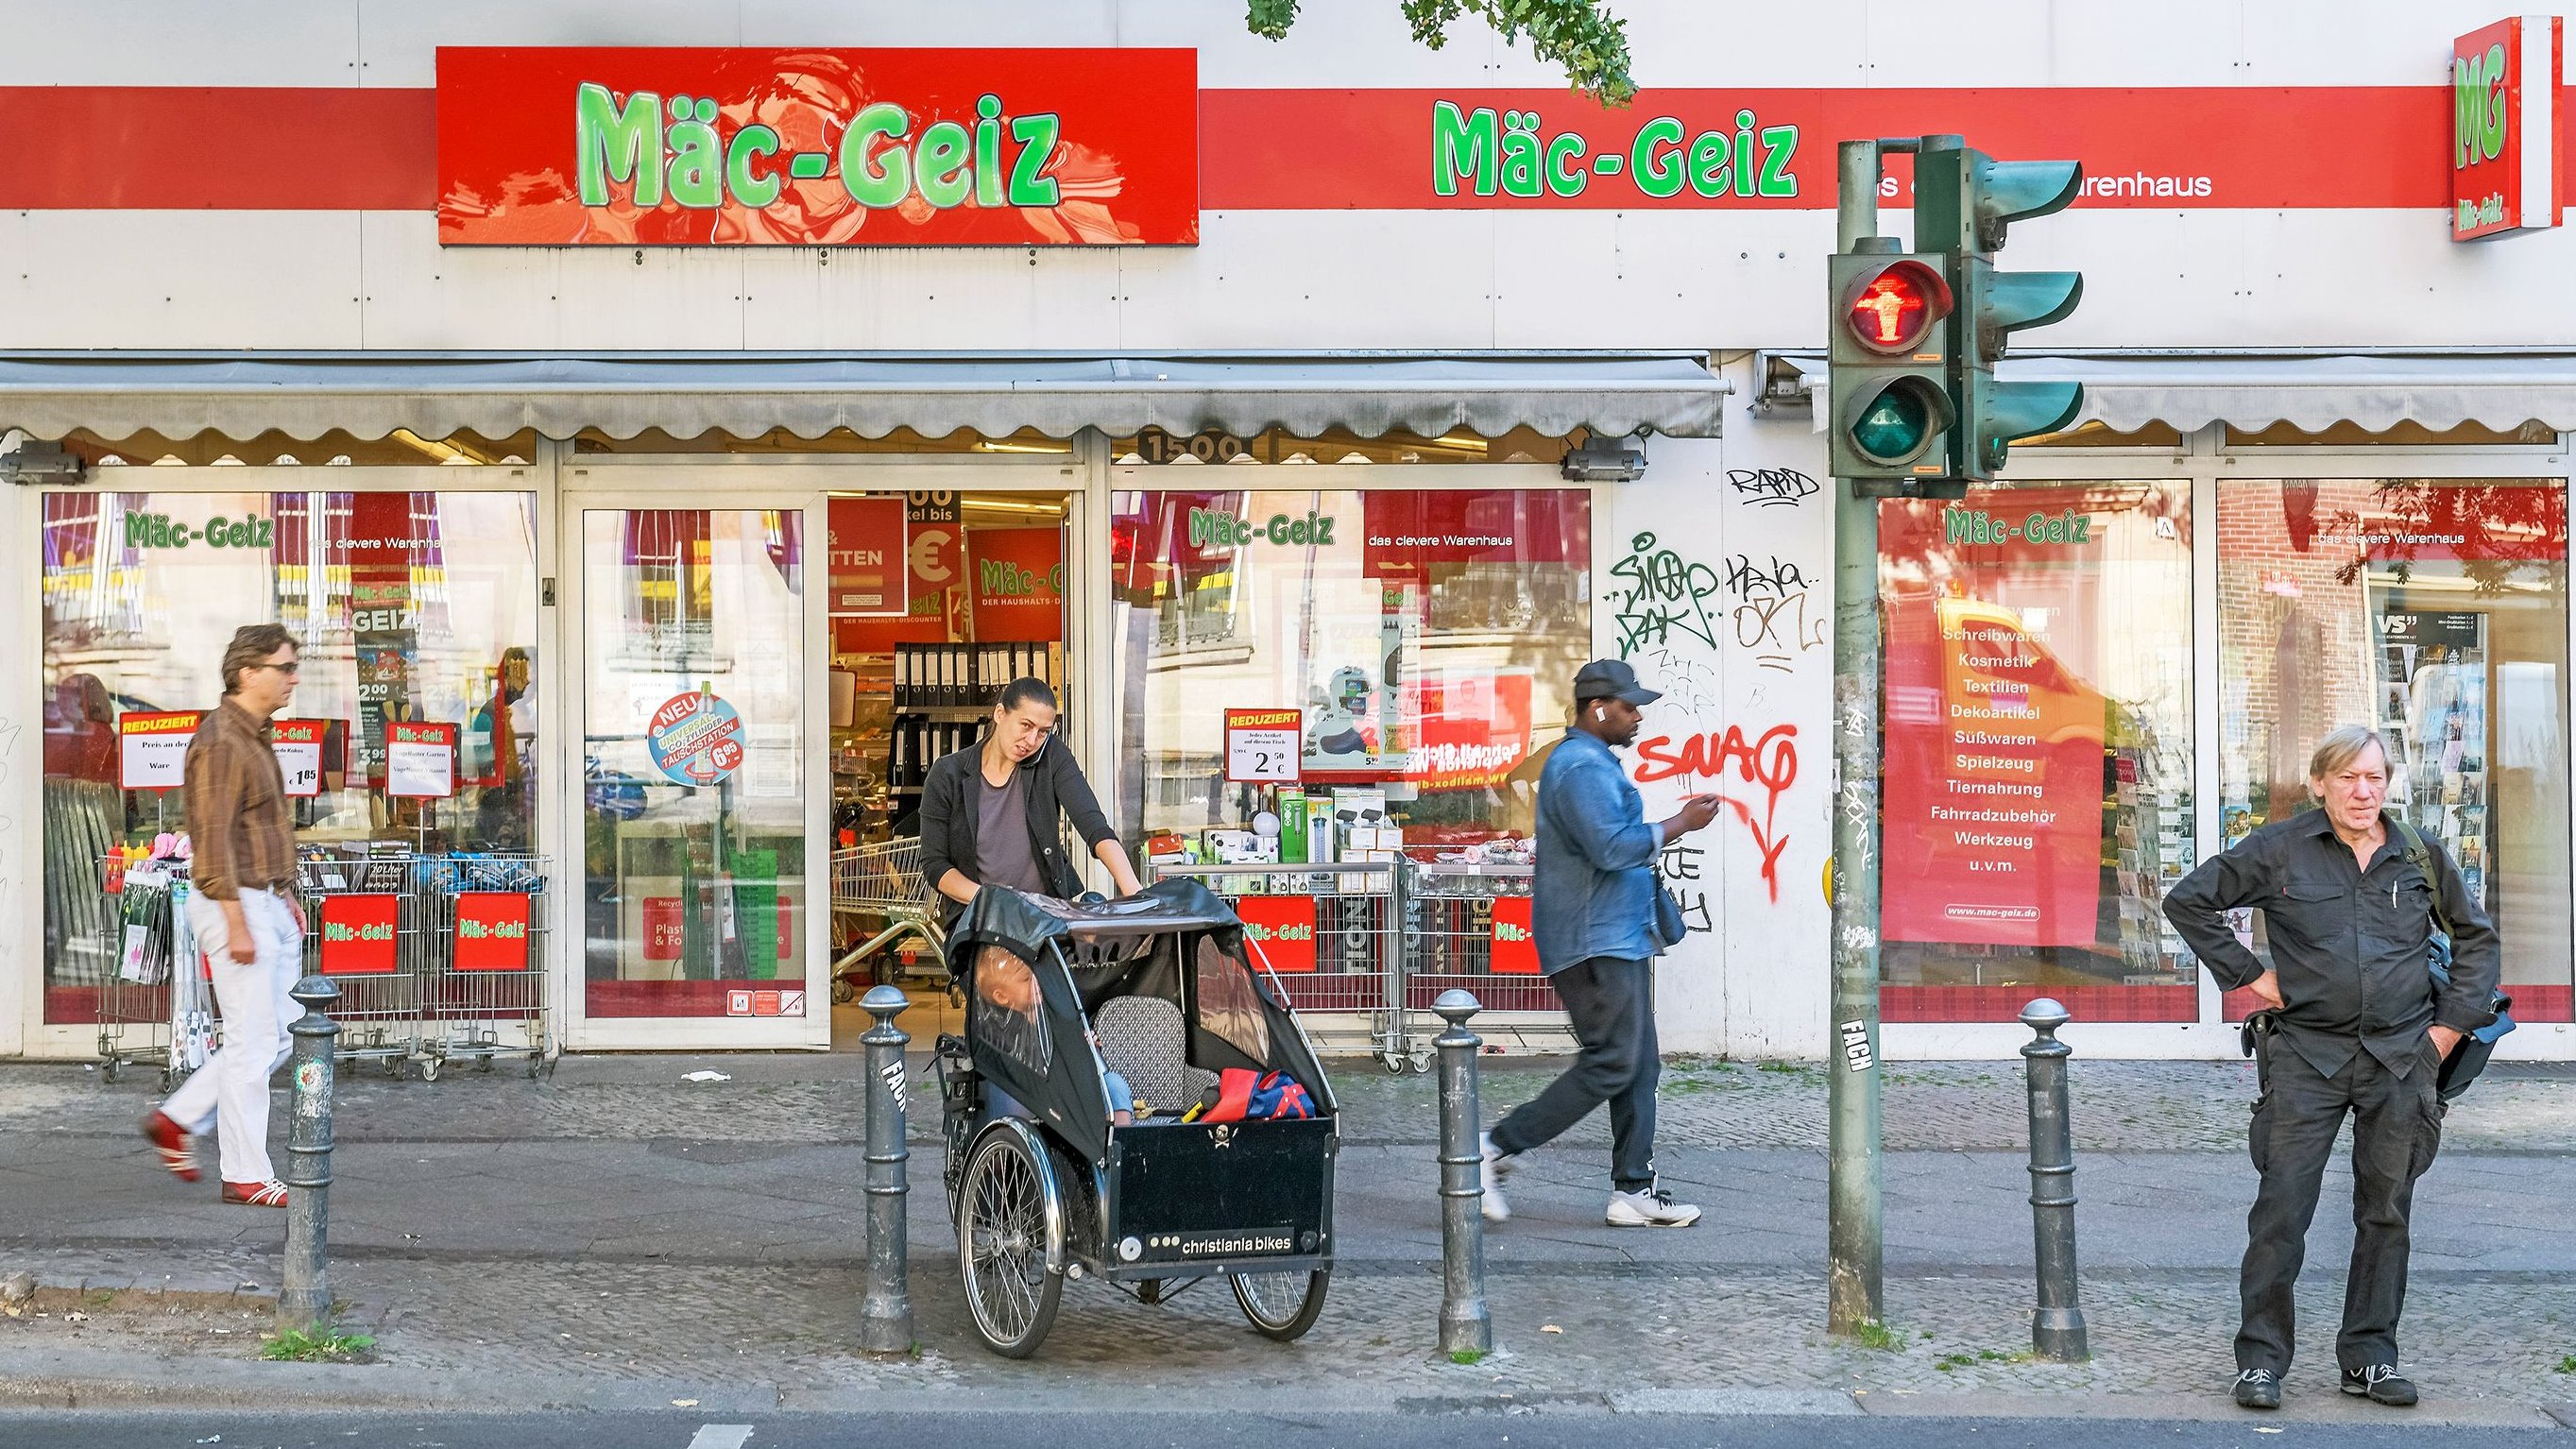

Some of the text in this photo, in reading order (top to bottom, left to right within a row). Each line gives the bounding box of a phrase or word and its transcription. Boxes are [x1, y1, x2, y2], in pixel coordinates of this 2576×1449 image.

[2455, 42, 2507, 171] MG
[575, 80, 1060, 210] Mäc-Geiz
[1433, 99, 1799, 197] Mäc-Geiz
[2078, 171, 2212, 196] renhaus
[1148, 435, 1243, 462] 1500
[930, 507, 953, 520] bis
[124, 509, 276, 550] Mäc-Geiz
[1188, 506, 1337, 548] Mäc-Geiz
[1945, 507, 2091, 545] Mäc-Geiz
[336, 537, 382, 549] clevere
[1369, 535, 1513, 546] das clevere Warenhaus
[2317, 534, 2465, 544] das clevere Warenhaus
[828, 550, 883, 566] TTEN
[352, 608, 417, 633] GEIZ
[1942, 626, 2051, 642] Schreibwaren
[1958, 653, 2033, 668] Kosmetik
[1963, 678, 2029, 693] Textilien
[658, 694, 698, 725] NEU
[1951, 705, 2040, 720] Dekoartikel
[123, 715, 197, 733] REDUZIERT
[1229, 712, 1299, 727] REDUZIERT
[271, 726, 313, 741] äc-Geiz
[1954, 730, 2037, 746] Süßwaren
[661, 724, 734, 768] TAUSCHSTATION
[1254, 752, 1269, 774] 2
[1955, 754, 2034, 772] Spielzeug
[1946, 779, 2043, 798] Tiernahrung
[1930, 806, 2056, 823] Fahrradzubehör
[1954, 831, 2034, 849] Werkzeug
[1970, 860, 2017, 872] u.v.m.
[325, 922, 394, 942] Mäc-Geiz
[459, 918, 526, 938] Mäc-Geiz
[1495, 922, 1533, 941] Mäc-
[655, 935, 664, 946] &
[1841, 1019, 1873, 1072] FACH
[1182, 1236, 1291, 1255] christiania bikes
